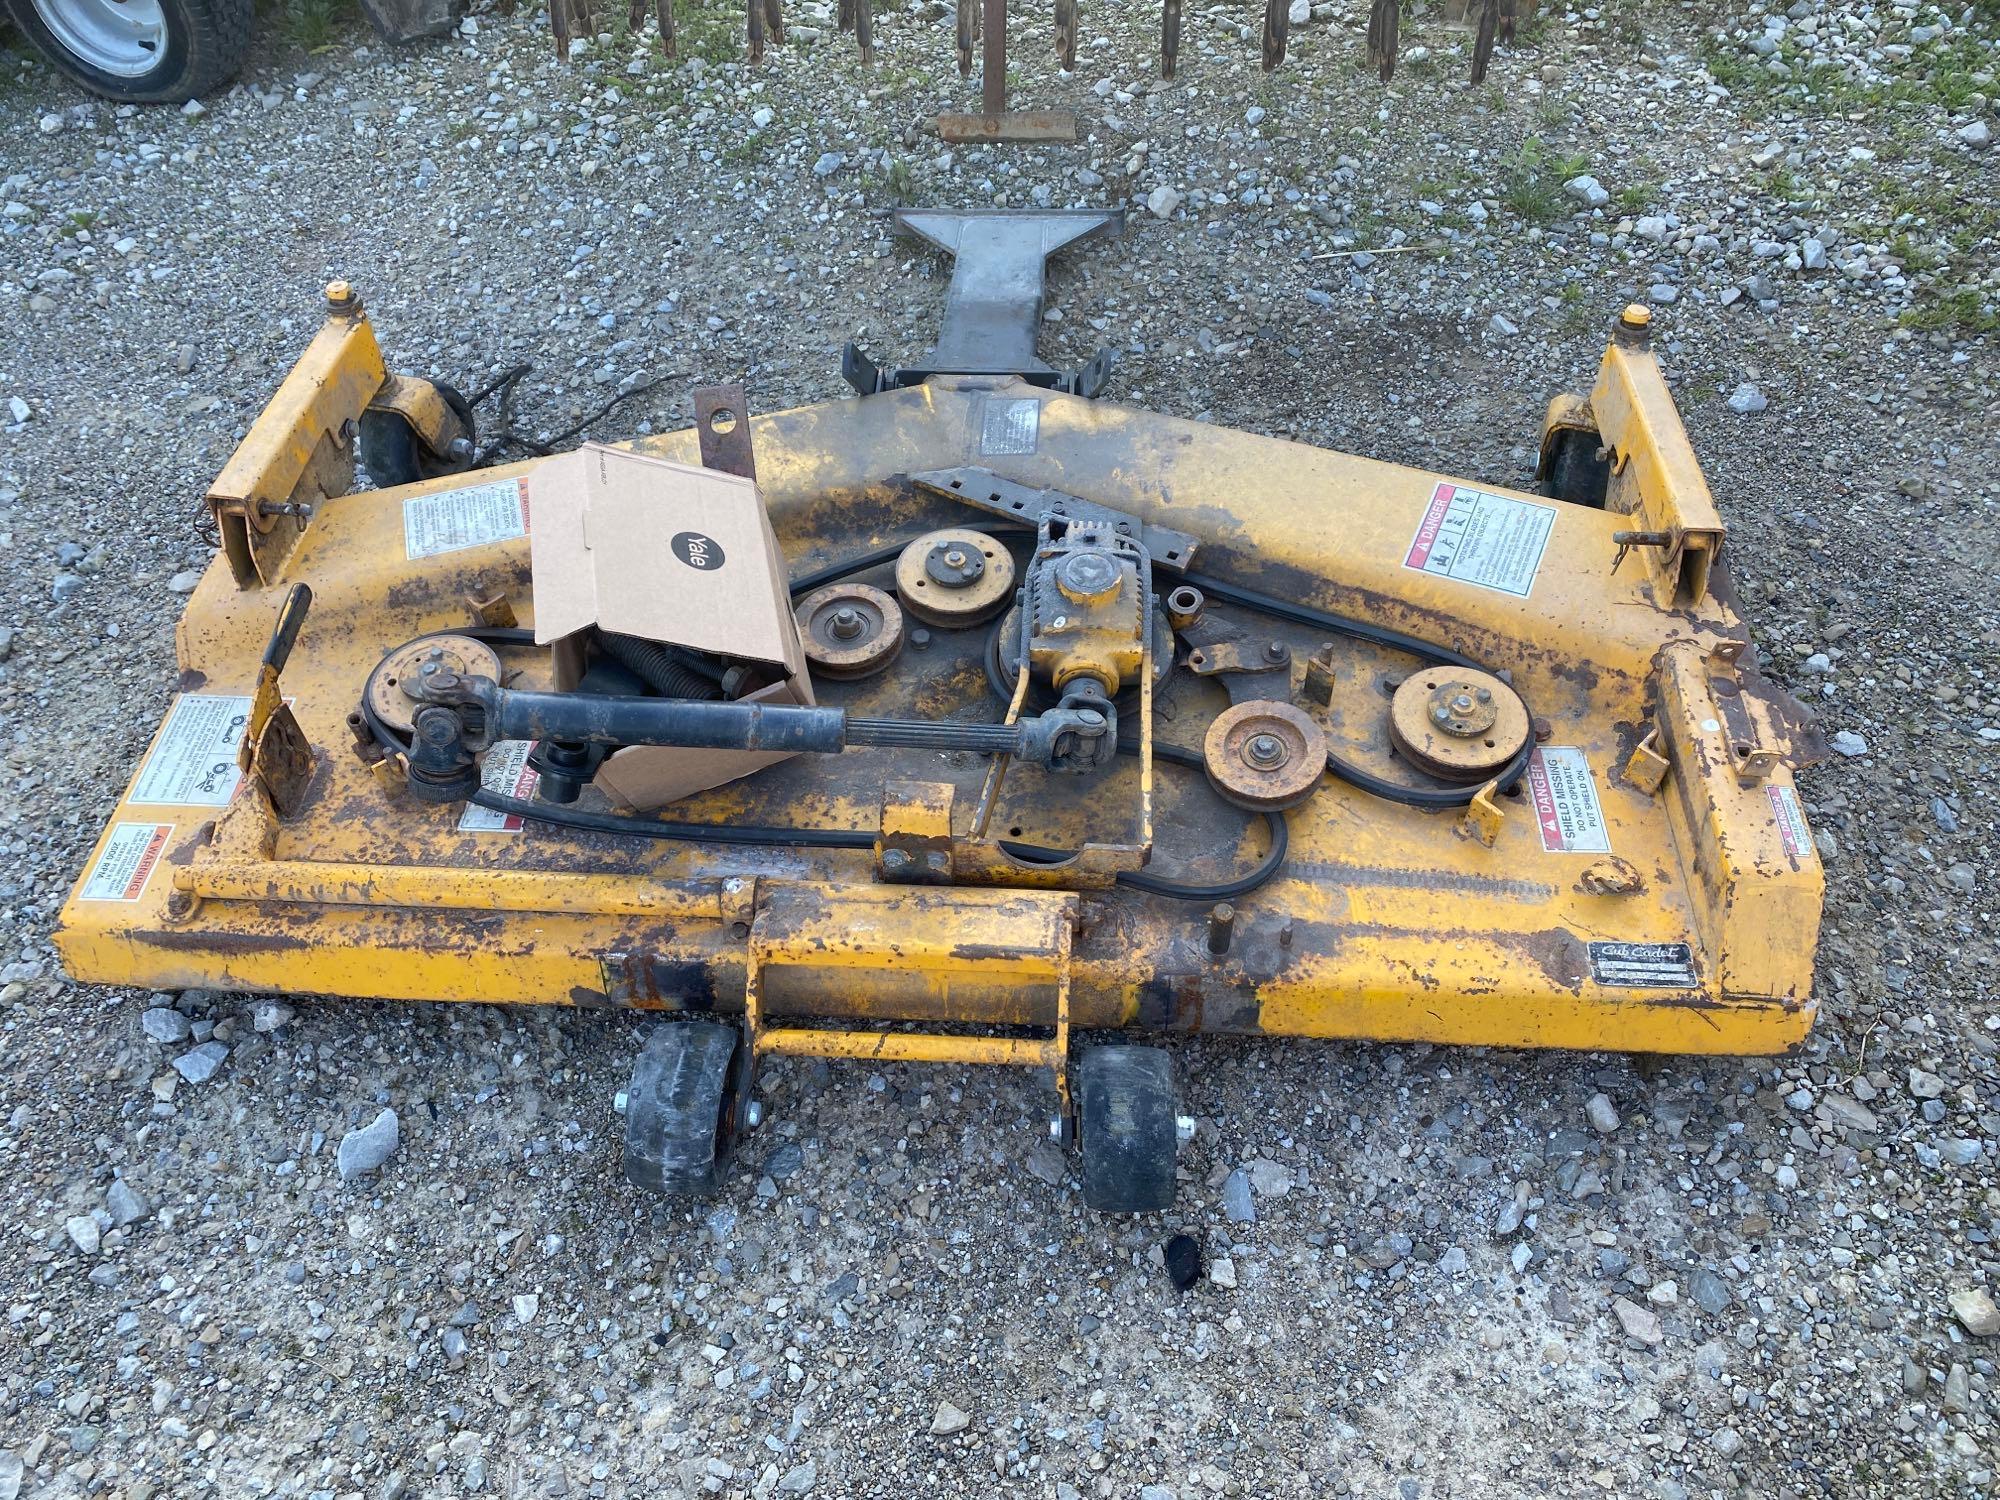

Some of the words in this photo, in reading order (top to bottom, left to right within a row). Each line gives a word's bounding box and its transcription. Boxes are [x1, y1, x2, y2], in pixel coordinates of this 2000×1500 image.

[1421, 499, 1448, 539] DANGER
[688, 538, 710, 566] Yale
[503, 748, 512, 759] DO
[508, 742, 527, 776] SHIELD
[1531, 765, 1552, 813] DANGER
[1548, 759, 1566, 799] MISSING
[1563, 766, 1578, 800] OPERATE
[1576, 770, 1585, 781] ON
[1573, 803, 1582, 818] NOT
[1580, 784, 1593, 810] SHIELD
[1559, 803, 1575, 838] SHIELD
[1576, 820, 1586, 831] DO
[1586, 812, 1597, 827] PUT
[1772, 797, 1790, 831] DANGER
[106, 842, 121, 860] 2000
[129, 845, 161, 891] WARNING
[1602, 945, 1629, 956] Cub
[1631, 946, 1680, 958] Cadet
